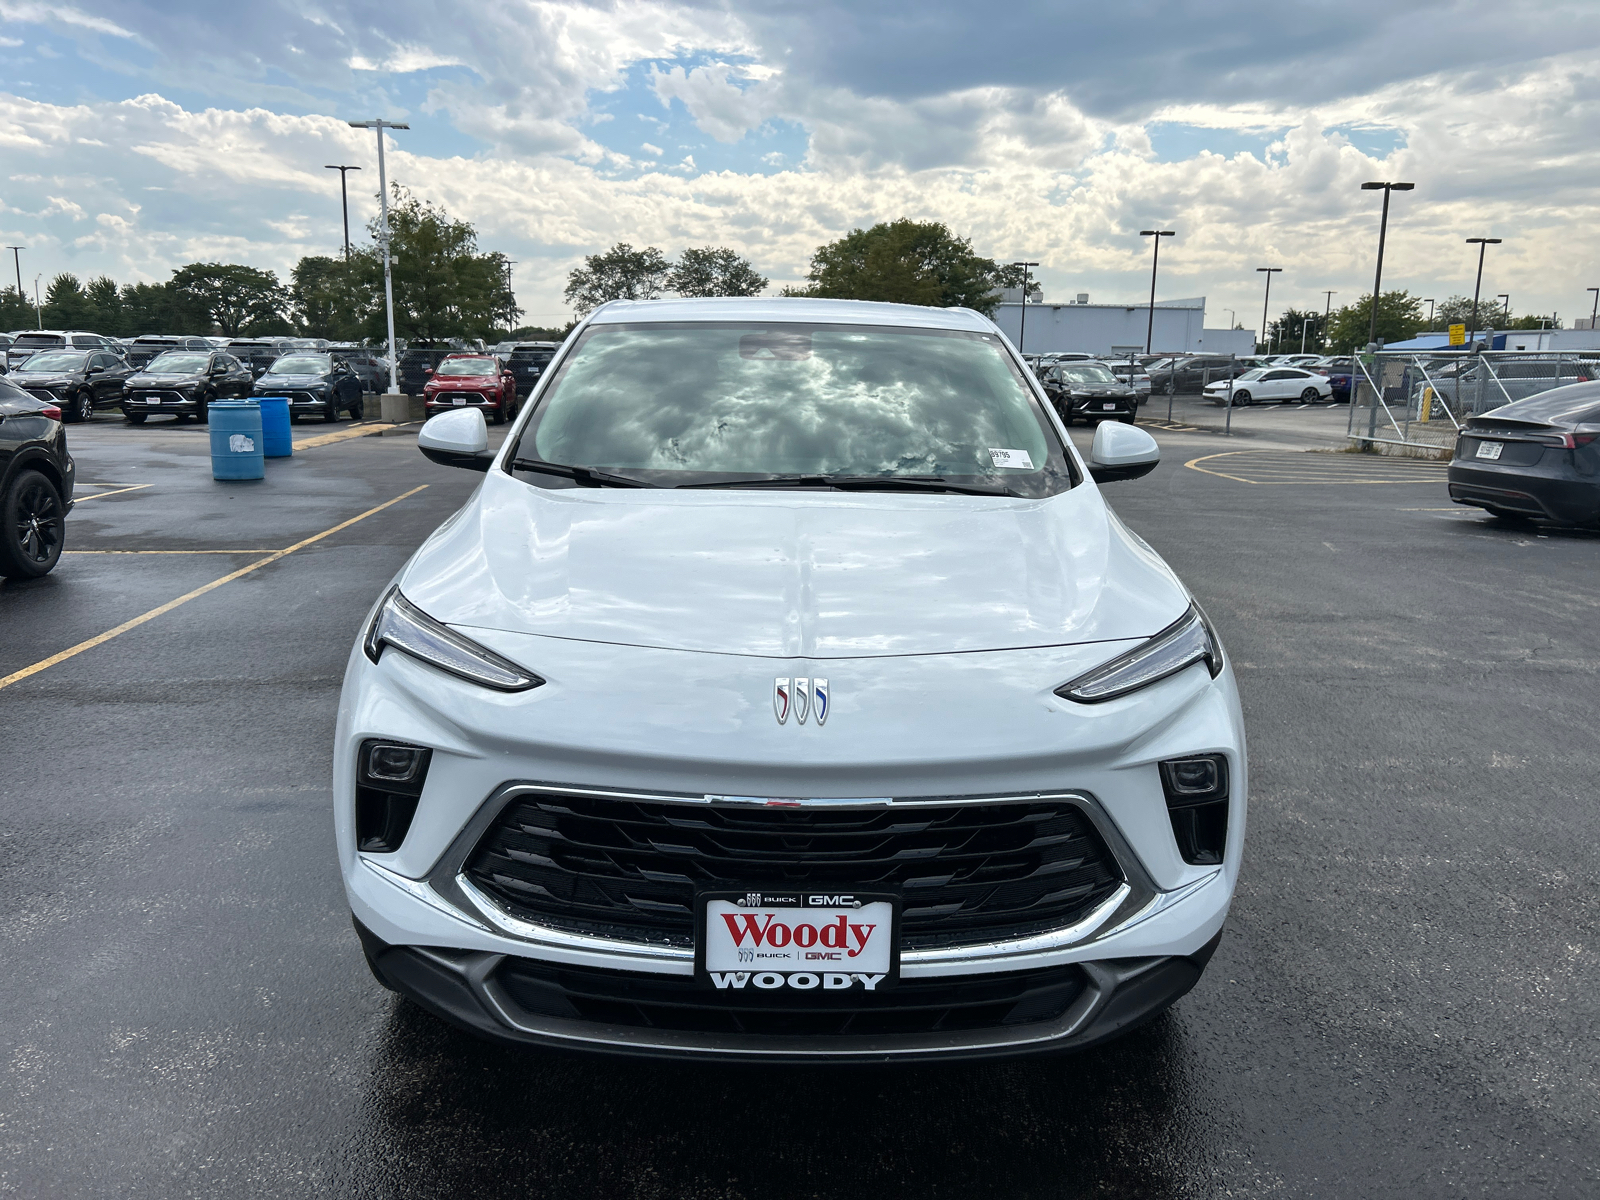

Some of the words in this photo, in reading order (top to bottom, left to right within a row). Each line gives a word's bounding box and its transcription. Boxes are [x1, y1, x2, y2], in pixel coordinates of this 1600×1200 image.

[808, 895, 854, 905] GMC
[720, 913, 877, 958] Woody
[805, 952, 842, 960] GMC
[709, 972, 886, 990] WOODY
